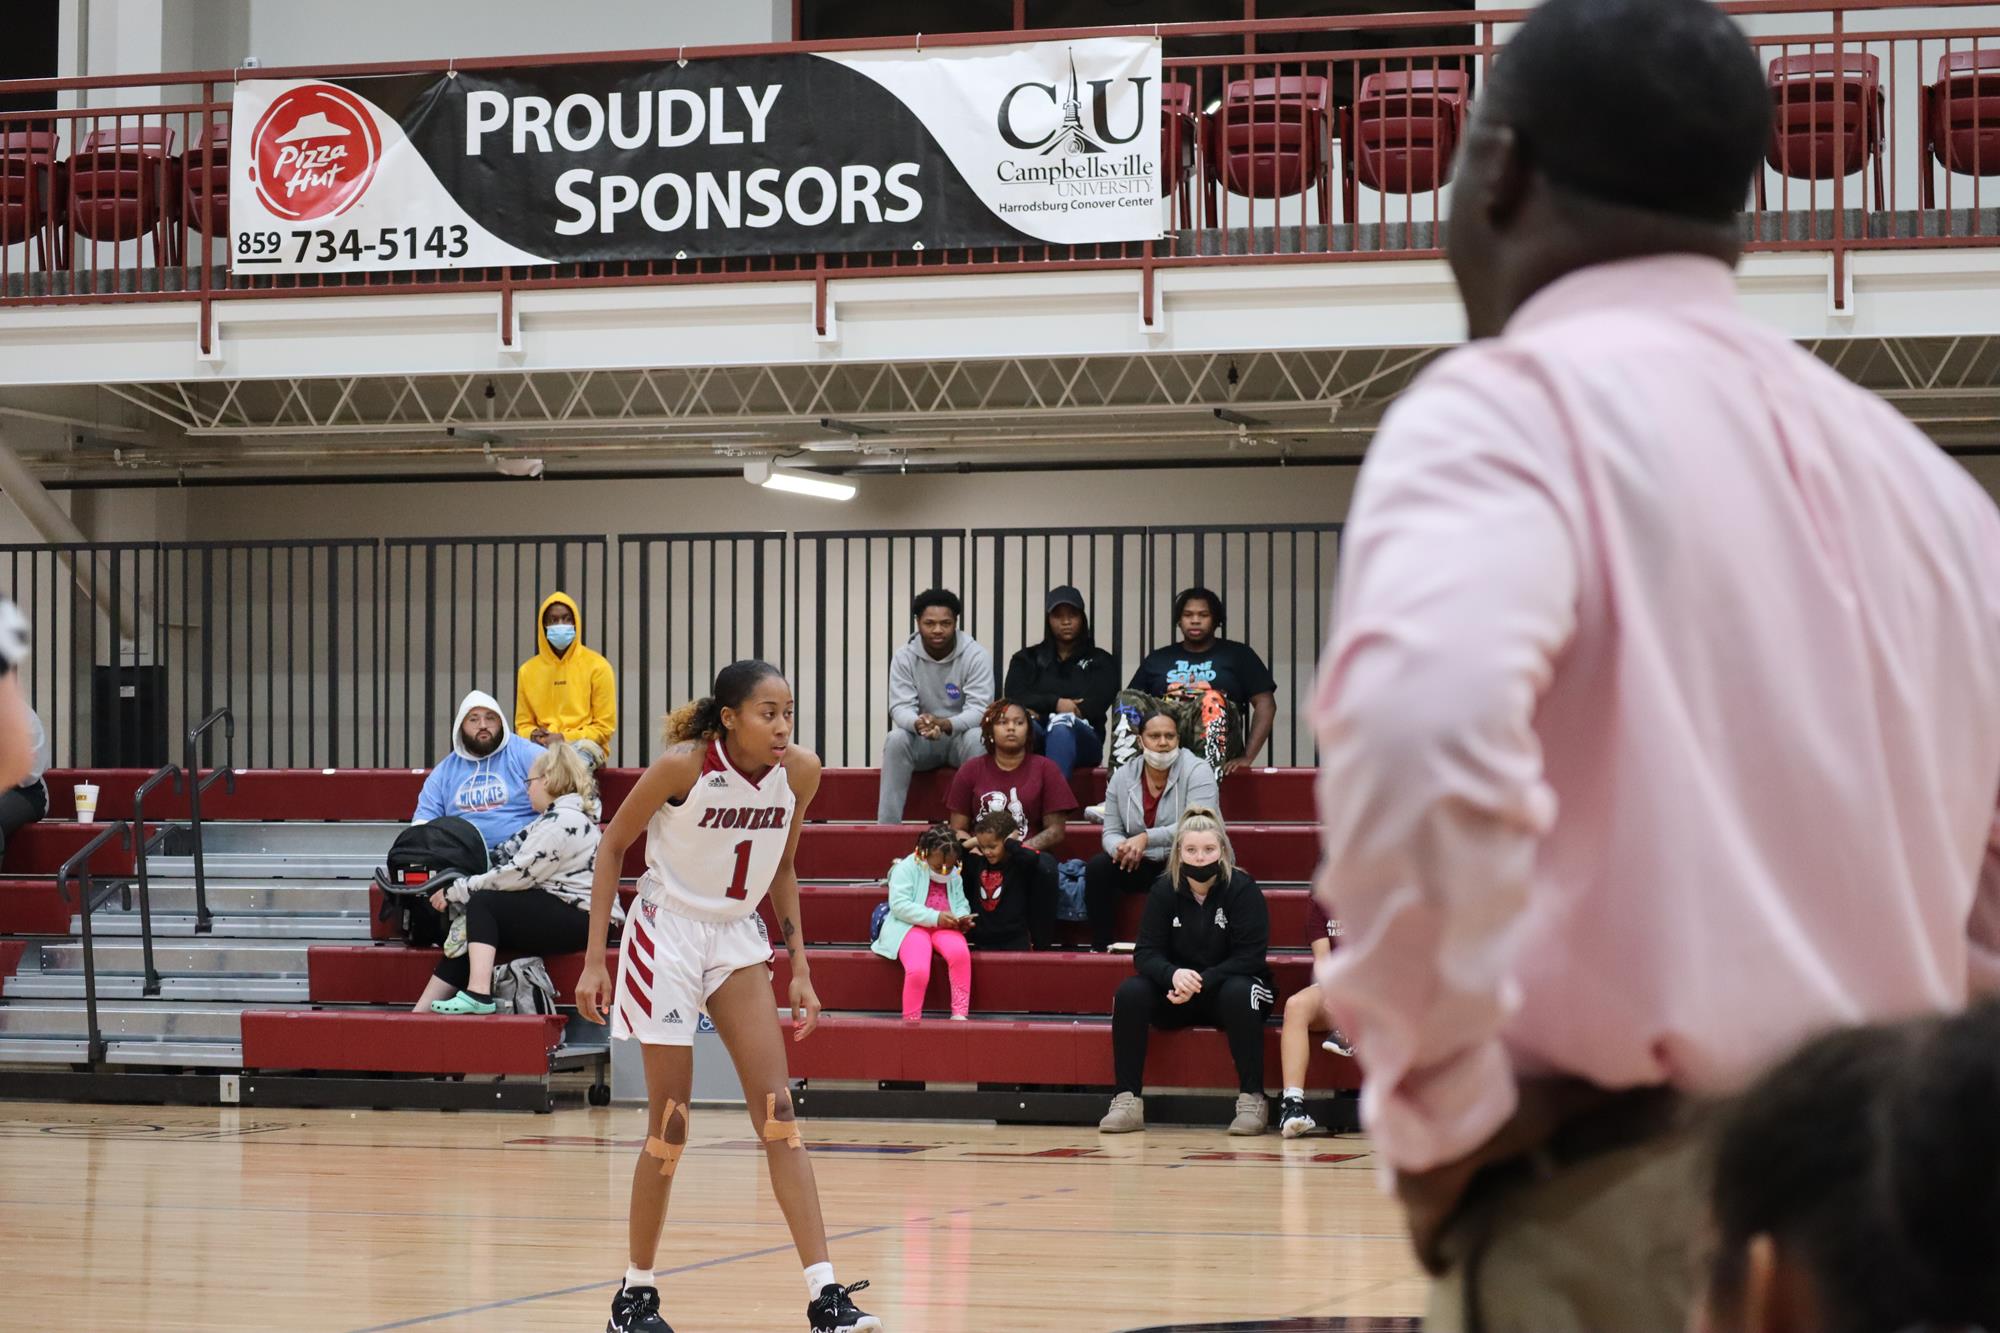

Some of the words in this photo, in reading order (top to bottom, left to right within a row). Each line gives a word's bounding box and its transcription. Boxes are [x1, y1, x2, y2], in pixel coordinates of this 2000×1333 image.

[466, 84, 783, 156] PROUDLY
[273, 141, 348, 176] Pizza
[997, 154, 1154, 185] Campbellsville
[284, 165, 345, 198] Hut
[1057, 179, 1152, 197] UNIVERSITY
[555, 162, 923, 236] SPONSORS
[999, 200, 1068, 213] Harrodsburg
[1071, 199, 1116, 210] Conover
[1118, 198, 1154, 208] Center
[237, 231, 281, 254] 859
[291, 225, 469, 263] 734-5143
[1166, 669, 1217, 684] SQUAD
[1175, 660, 1213, 672] TUNE
[697, 806, 791, 829] PIONEER
[725, 840, 753, 900] 1
